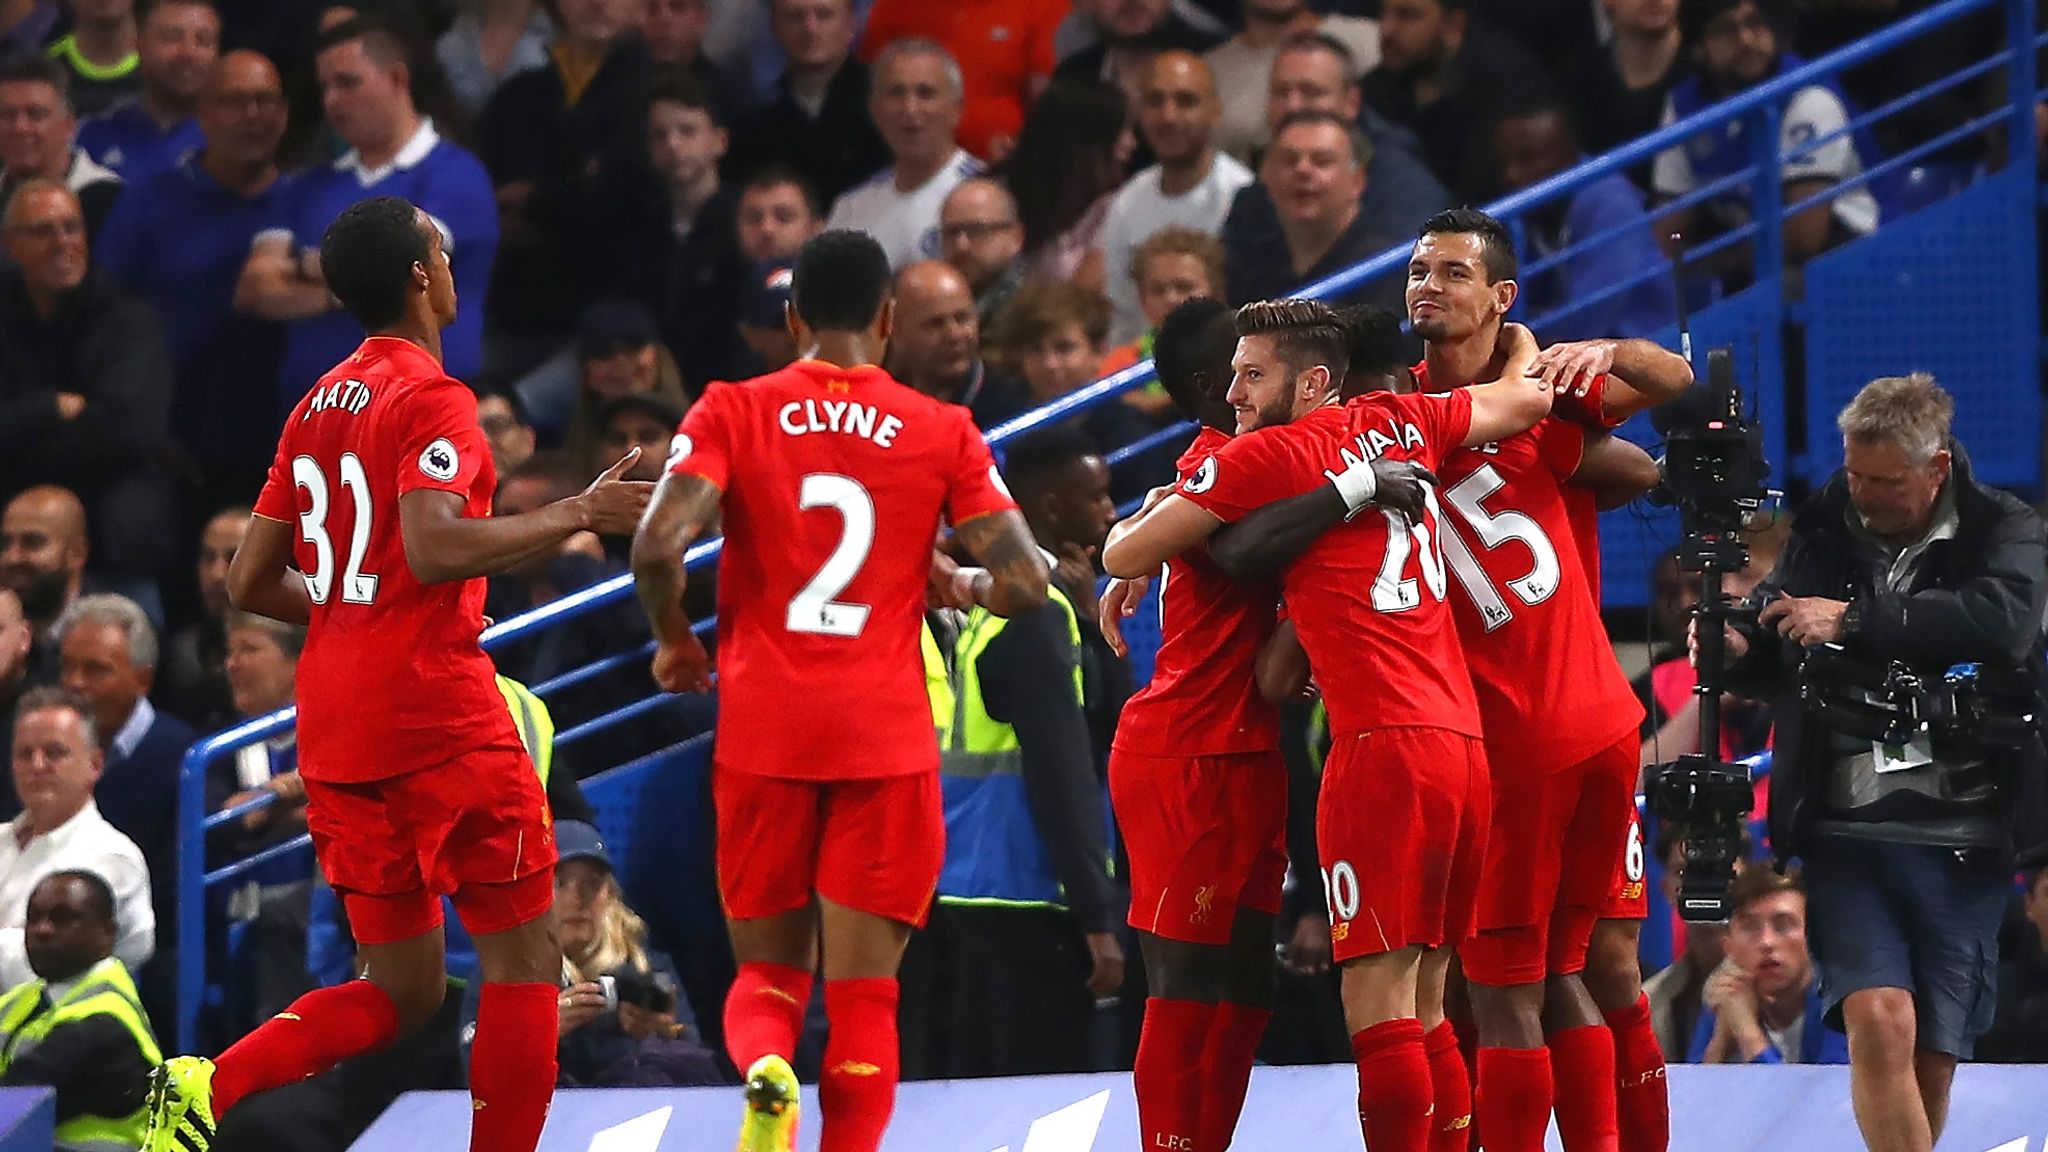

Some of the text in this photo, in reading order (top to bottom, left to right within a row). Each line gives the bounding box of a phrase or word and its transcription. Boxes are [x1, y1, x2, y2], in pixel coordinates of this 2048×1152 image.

[778, 399, 904, 448] CLYNE
[292, 452, 379, 605] 32
[785, 471, 876, 638] 2
[1438, 461, 1561, 633] 15
[1624, 821, 1645, 882] 6
